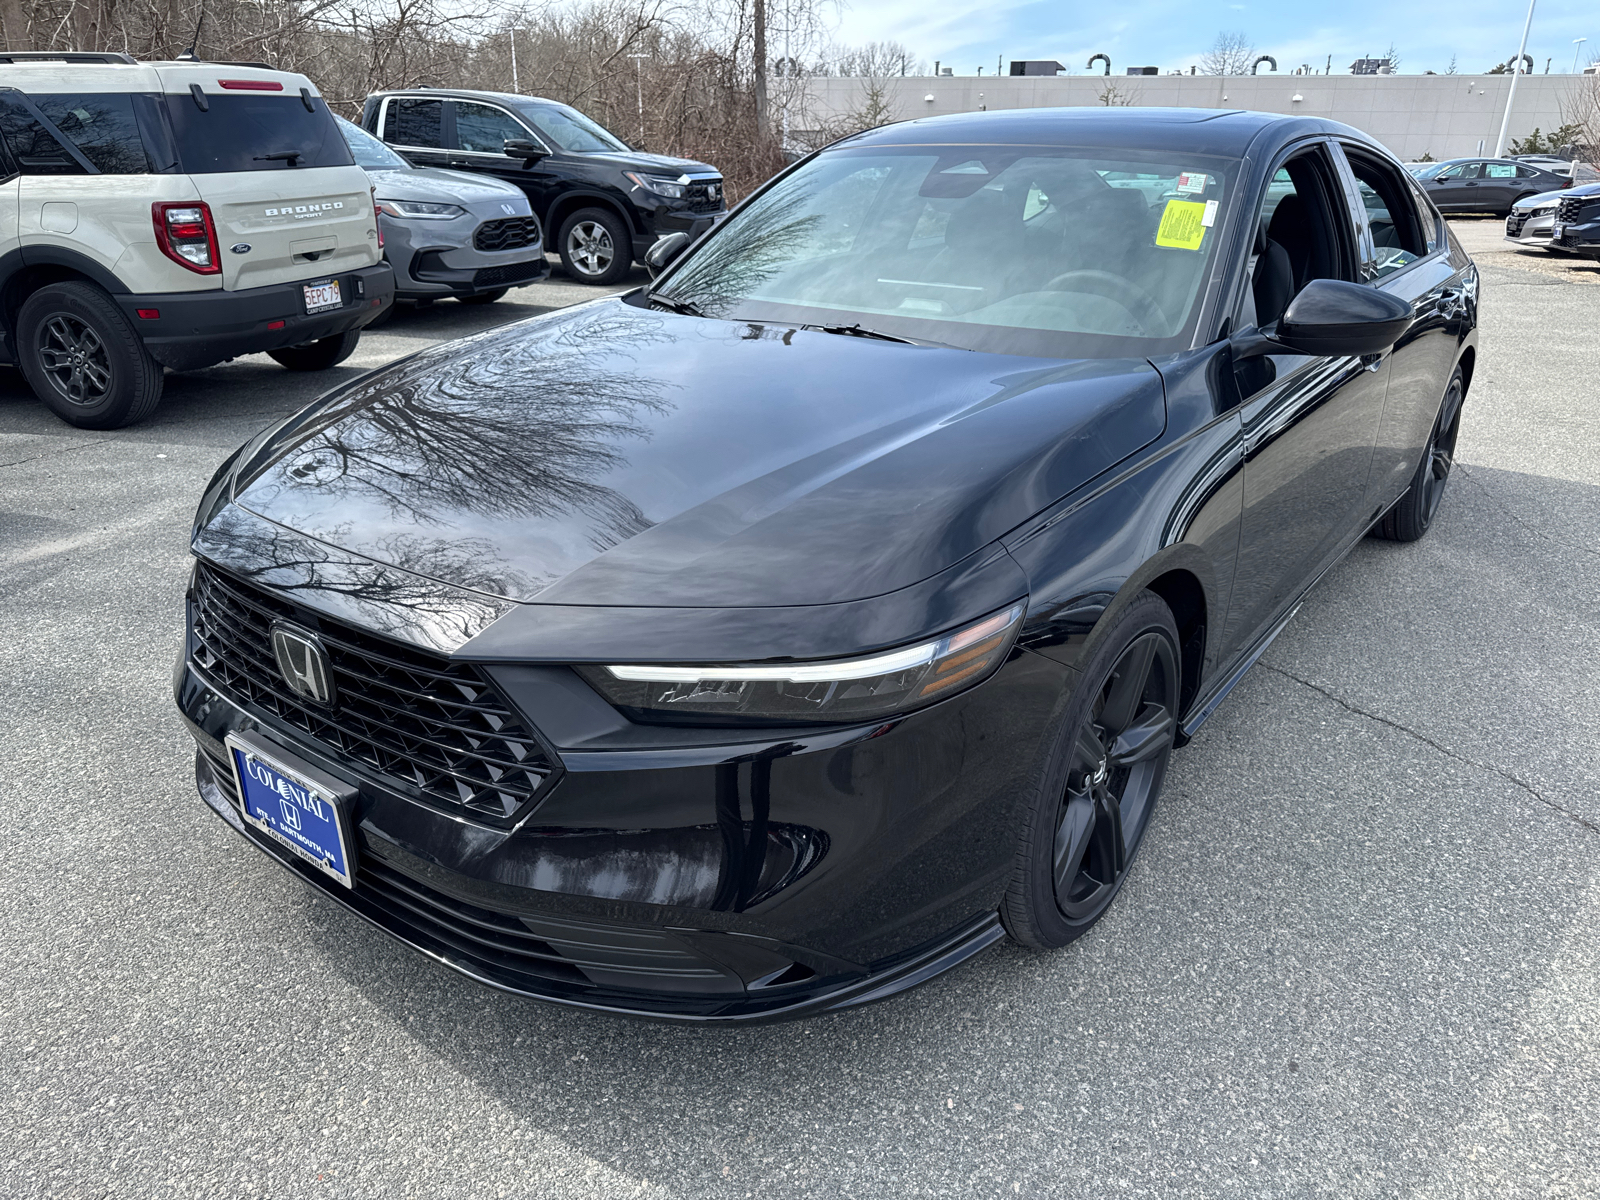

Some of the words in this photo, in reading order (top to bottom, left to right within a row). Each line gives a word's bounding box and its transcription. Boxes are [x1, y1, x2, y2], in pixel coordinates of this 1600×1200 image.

[265, 201, 344, 217] BRONCO
[294, 211, 323, 220] SPORT
[233, 243, 250, 254] Ford
[246, 758, 329, 823] COLONIAL
[268, 829, 299, 854] COLONIAL
[299, 851, 324, 870] HONDA
[279, 822, 324, 856] DARTMOUTH,
[324, 849, 336, 863] MA
